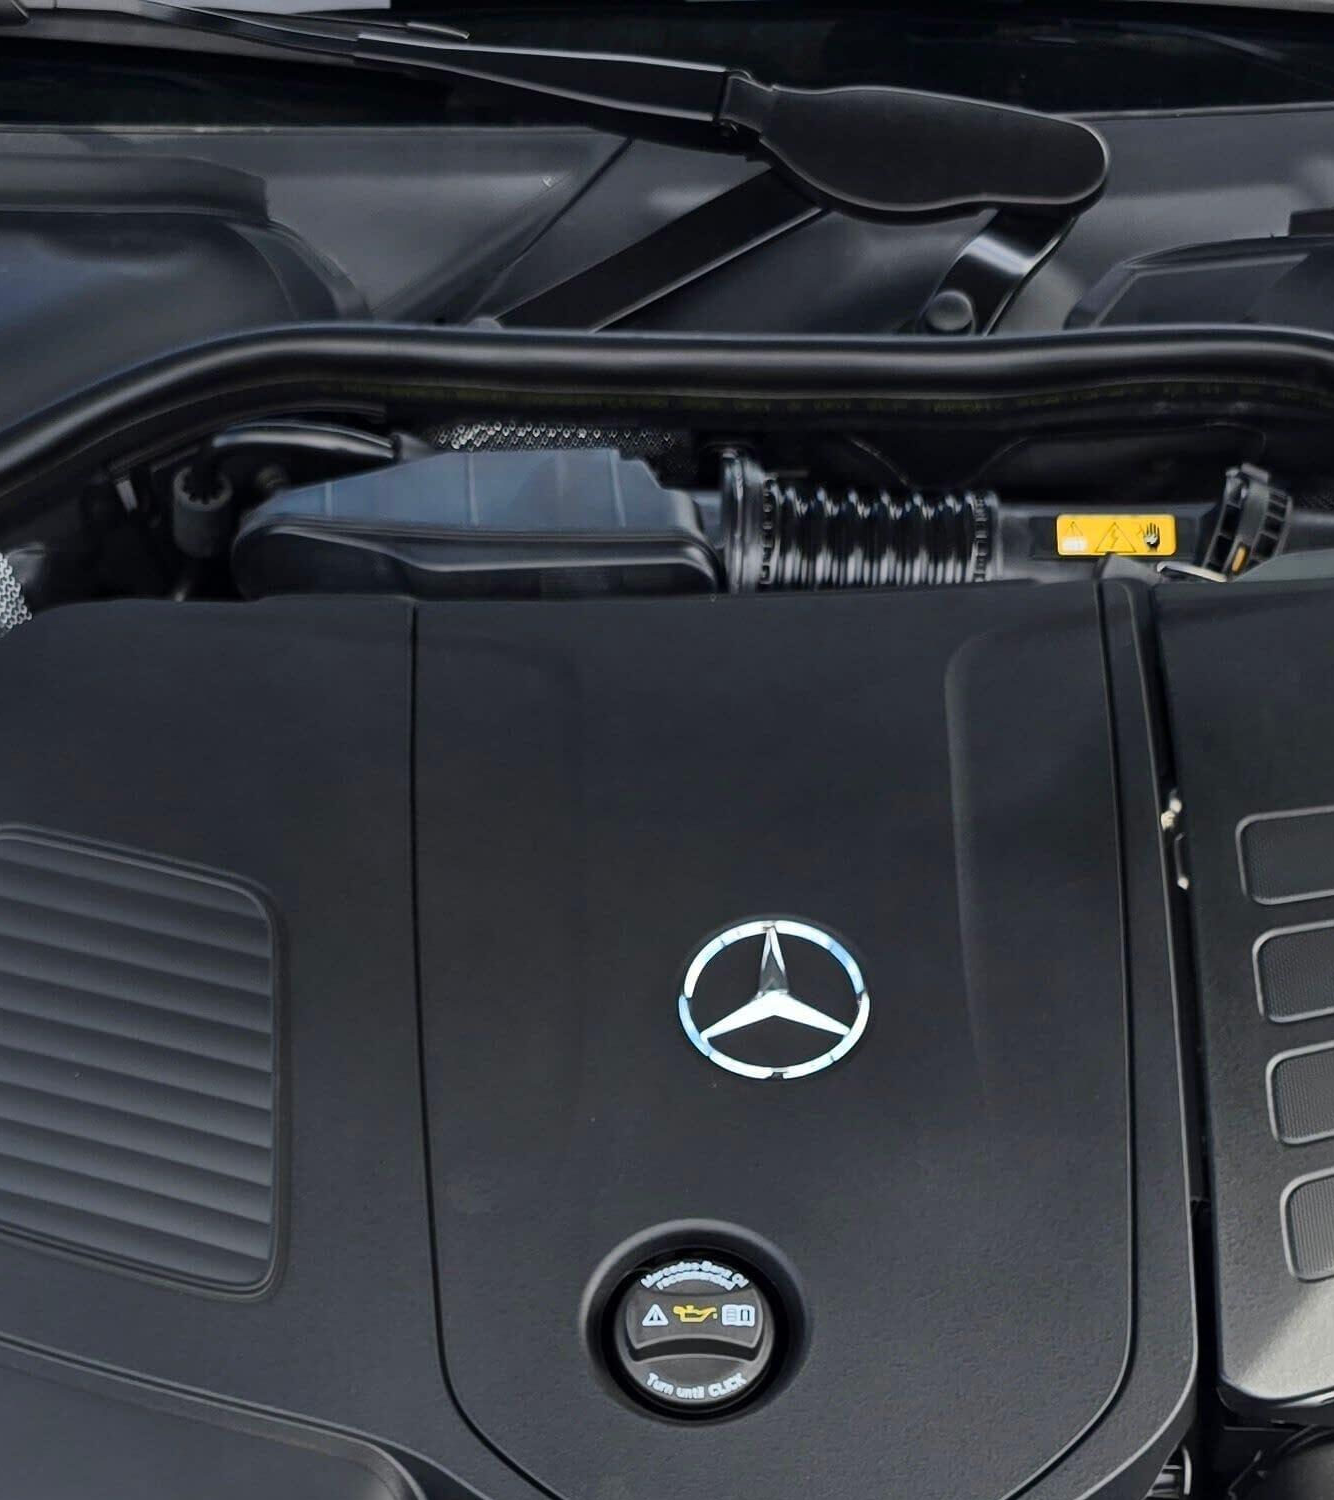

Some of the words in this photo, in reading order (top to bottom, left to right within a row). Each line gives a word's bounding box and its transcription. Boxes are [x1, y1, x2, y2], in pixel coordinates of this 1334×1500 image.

[646, 1373, 673, 1395] Turn
[676, 1385, 705, 1400] until
[708, 1372, 747, 1398] CLICK
